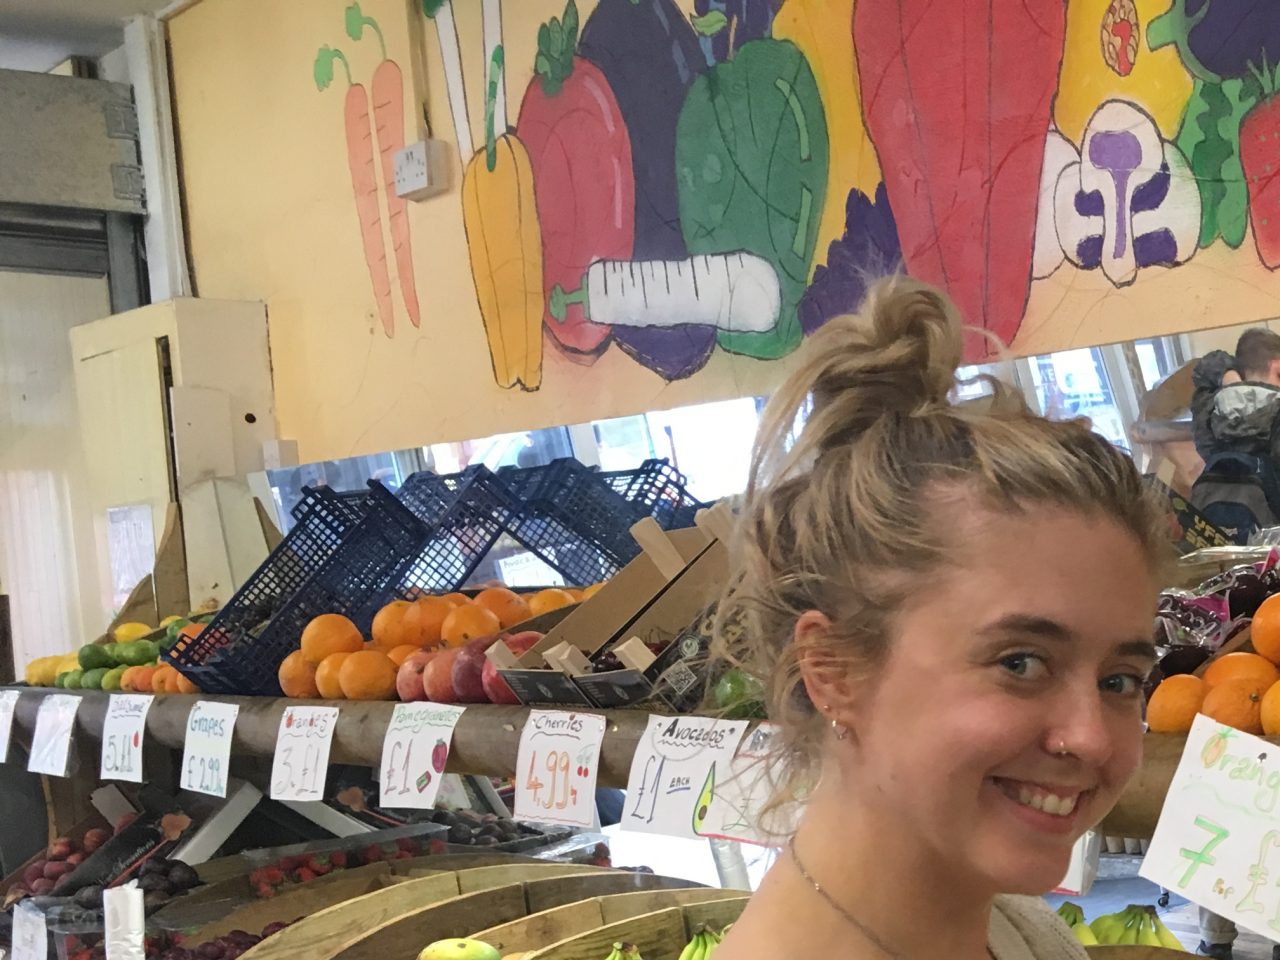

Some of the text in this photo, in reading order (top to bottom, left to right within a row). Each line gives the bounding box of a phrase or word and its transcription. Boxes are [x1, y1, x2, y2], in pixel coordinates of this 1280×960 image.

[190, 706, 225, 737] Grapes
[535, 714, 583, 733] Cherries
[384, 739, 414, 795] £1
[631, 755, 667, 824] £1
[1178, 815, 1230, 890] 7
